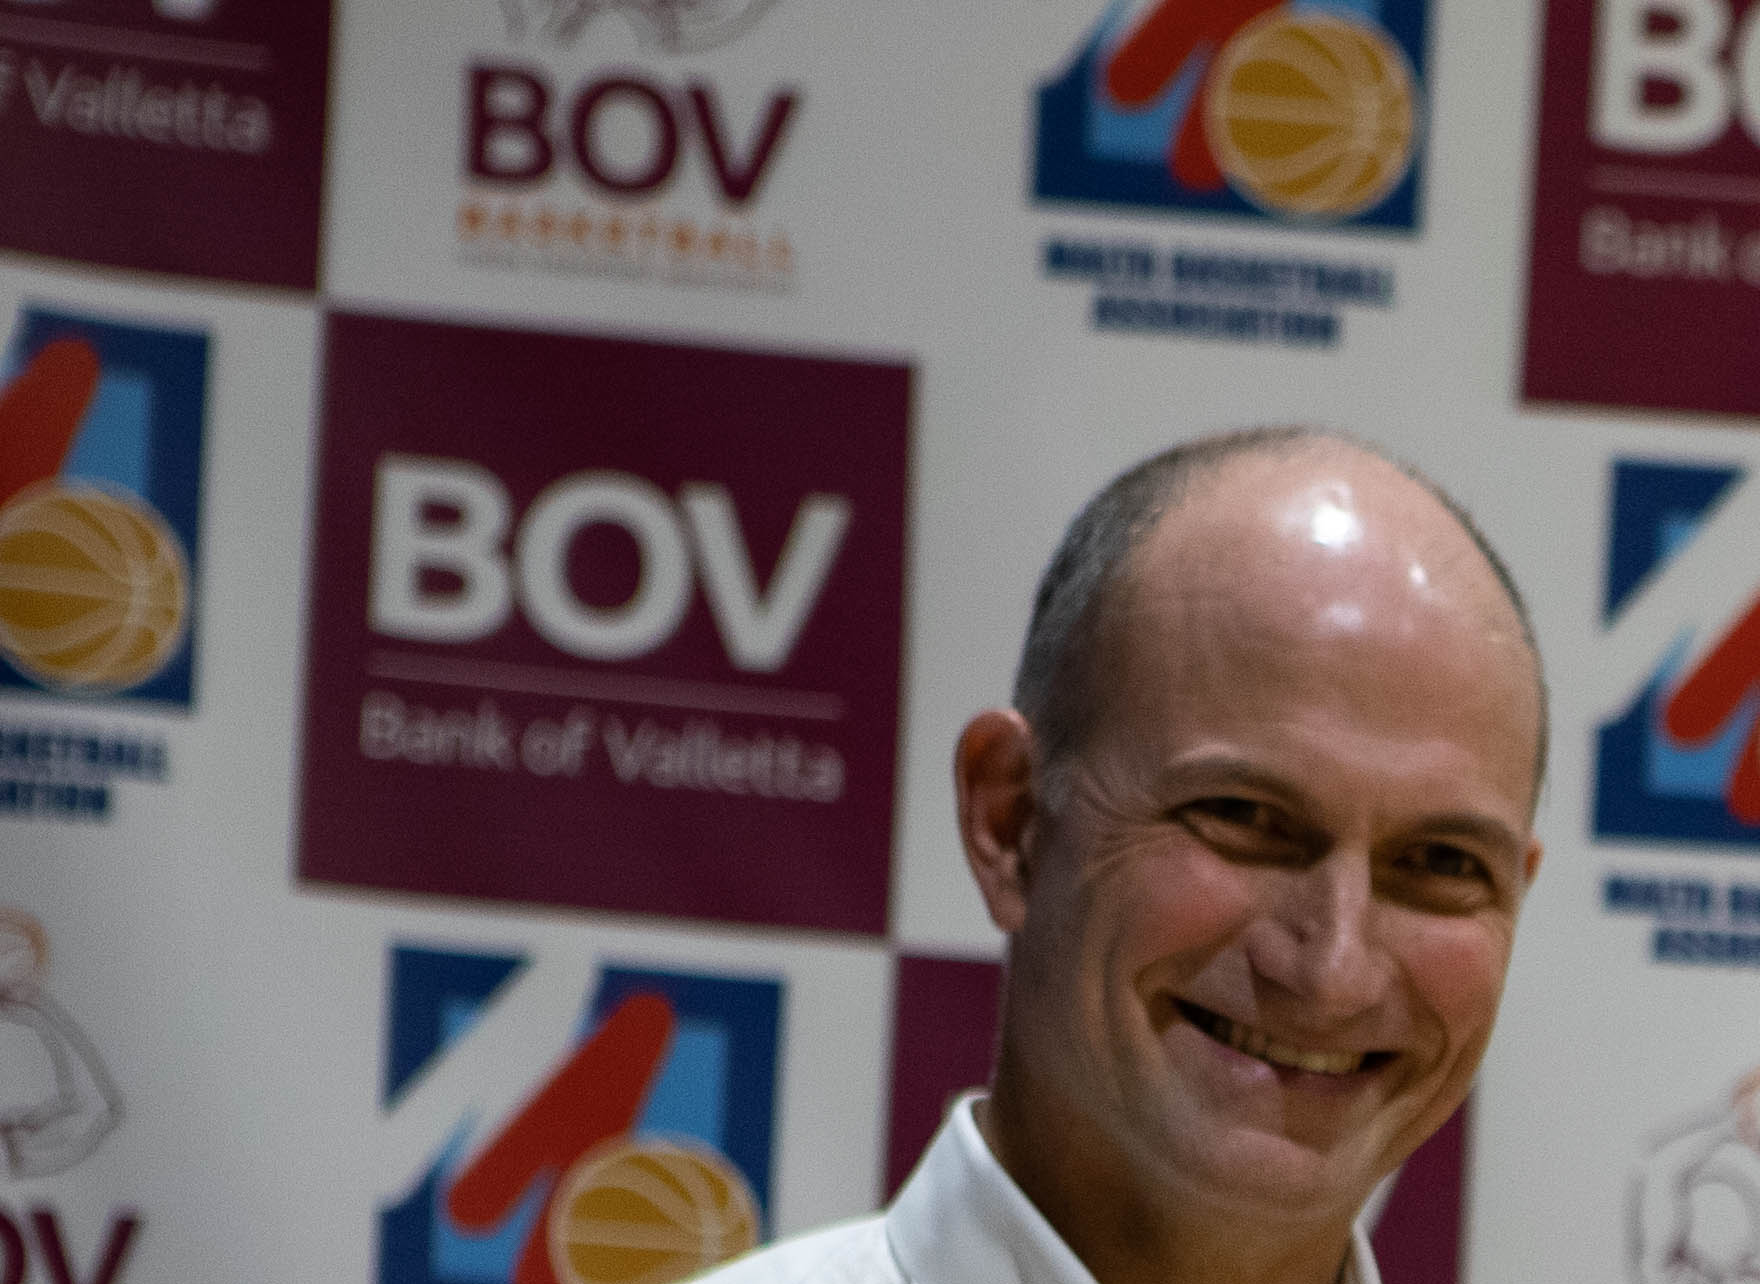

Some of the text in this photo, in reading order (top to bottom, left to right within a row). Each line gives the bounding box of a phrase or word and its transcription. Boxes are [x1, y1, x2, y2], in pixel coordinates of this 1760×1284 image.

[463, 62, 798, 208] BOV
[1583, 208, 1730, 286] Bank
[369, 452, 851, 671] BOV
[360, 697, 846, 802] Bank of Valletta
